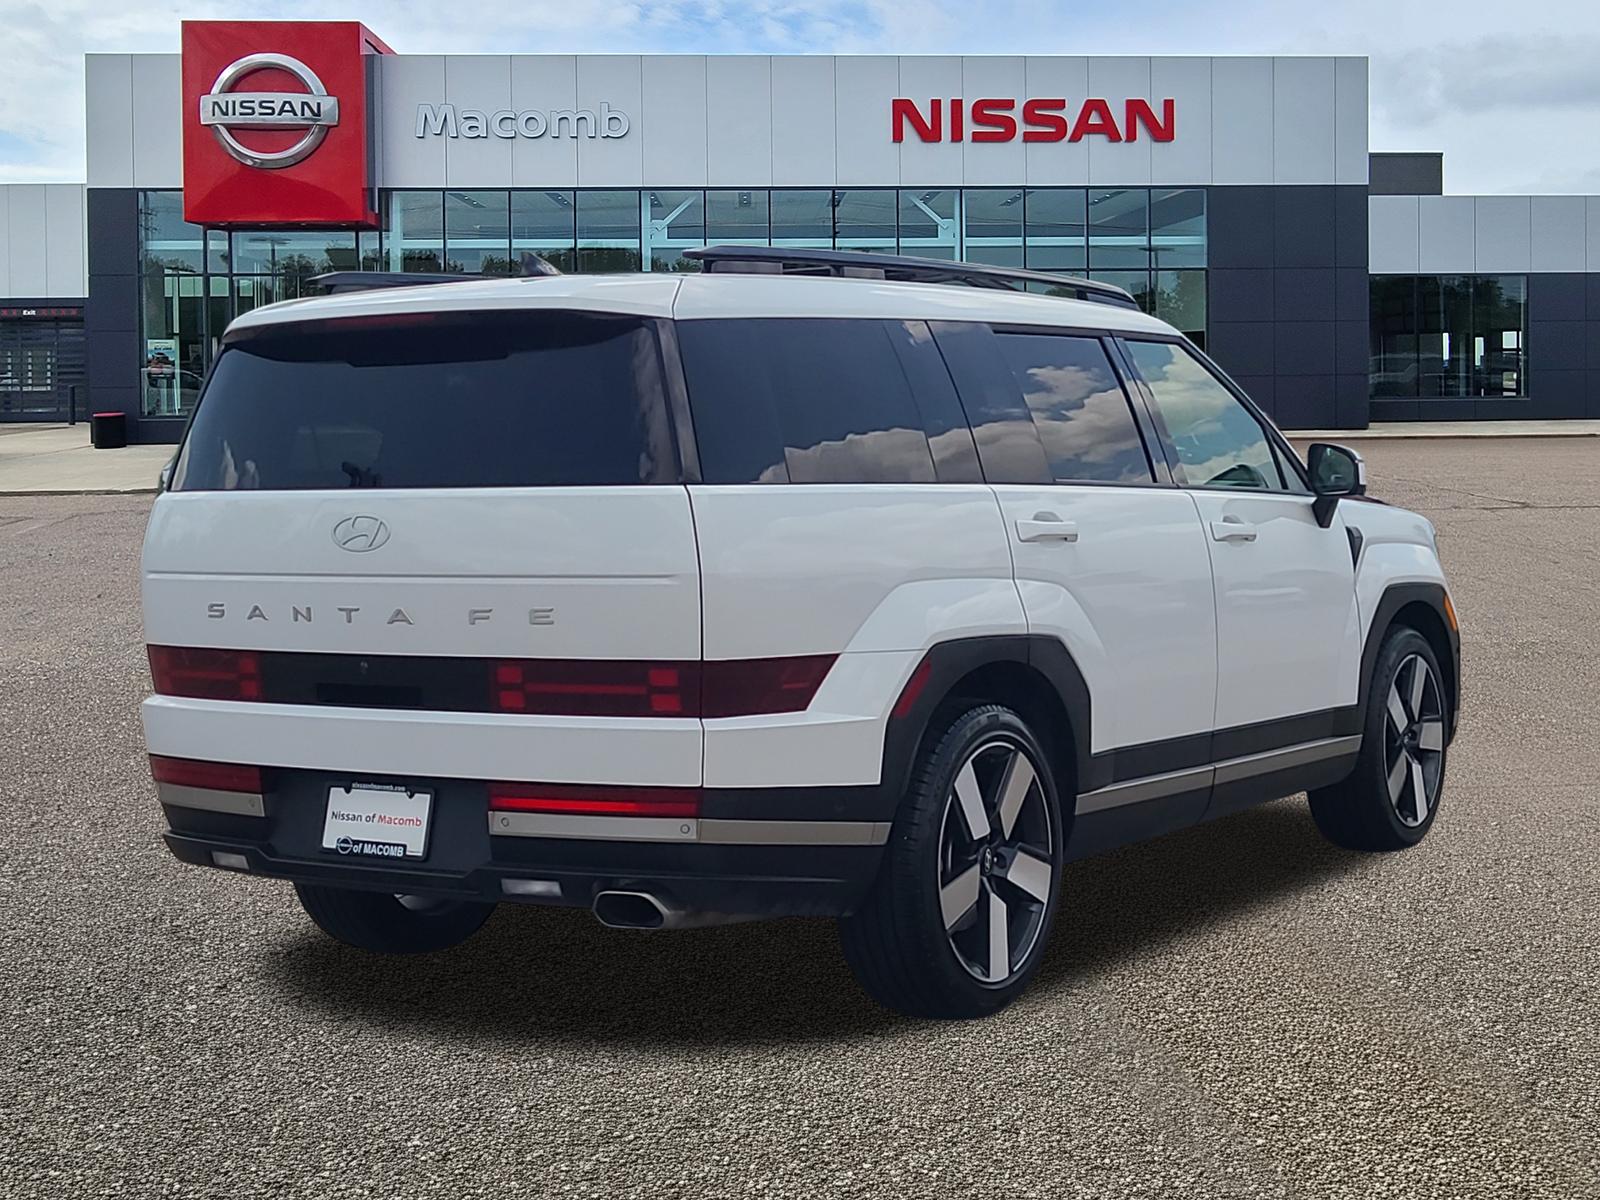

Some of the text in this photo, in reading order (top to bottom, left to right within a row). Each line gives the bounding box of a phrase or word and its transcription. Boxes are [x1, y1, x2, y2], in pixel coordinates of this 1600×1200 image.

[211, 99, 322, 118] NISSAN
[415, 102, 630, 138] Macomb
[891, 98, 1176, 143] NISSAN
[207, 602, 555, 626] SANTA FE
[330, 810, 422, 827] Nissan of Macomb
[352, 842, 404, 857] of MACOMB
